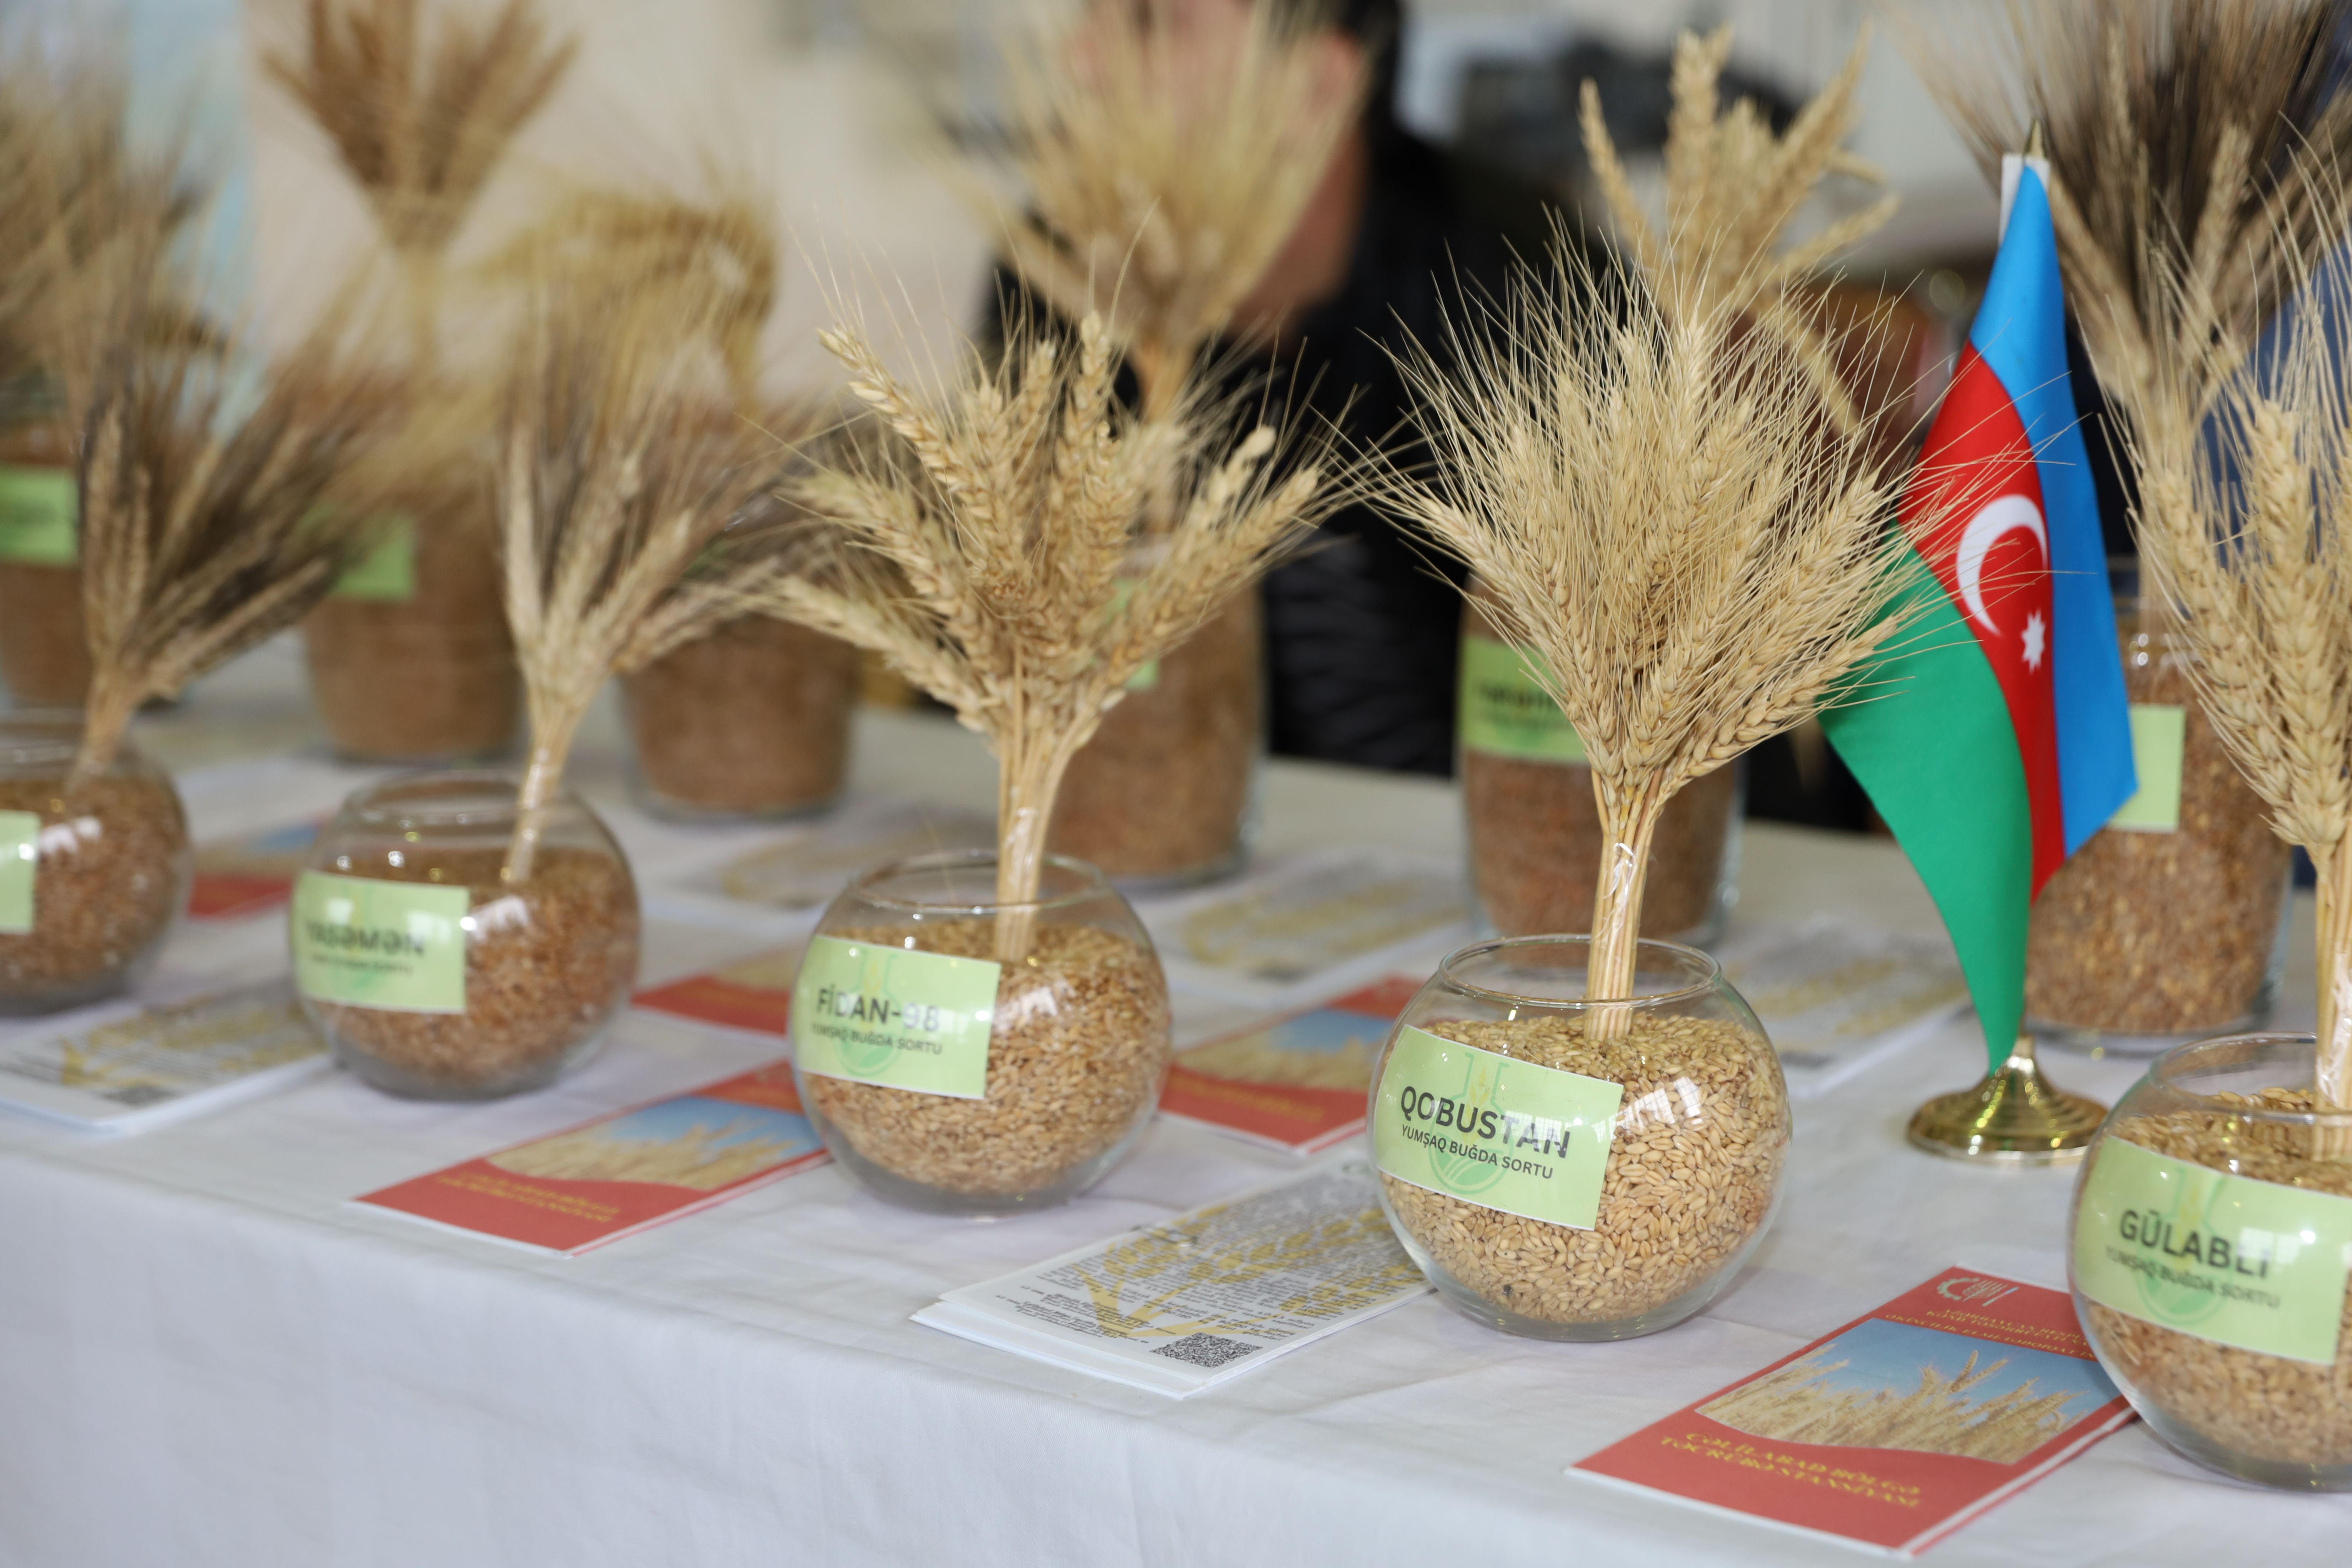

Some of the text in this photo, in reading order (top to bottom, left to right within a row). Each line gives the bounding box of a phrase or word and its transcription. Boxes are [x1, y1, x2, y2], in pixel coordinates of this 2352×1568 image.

[897, 1038, 943, 1055] SORTU
[1401, 1086, 1571, 1159] QOBUSTAN
[1402, 1124, 1553, 1179] YUMŞAQ BUĞDA SORTU
